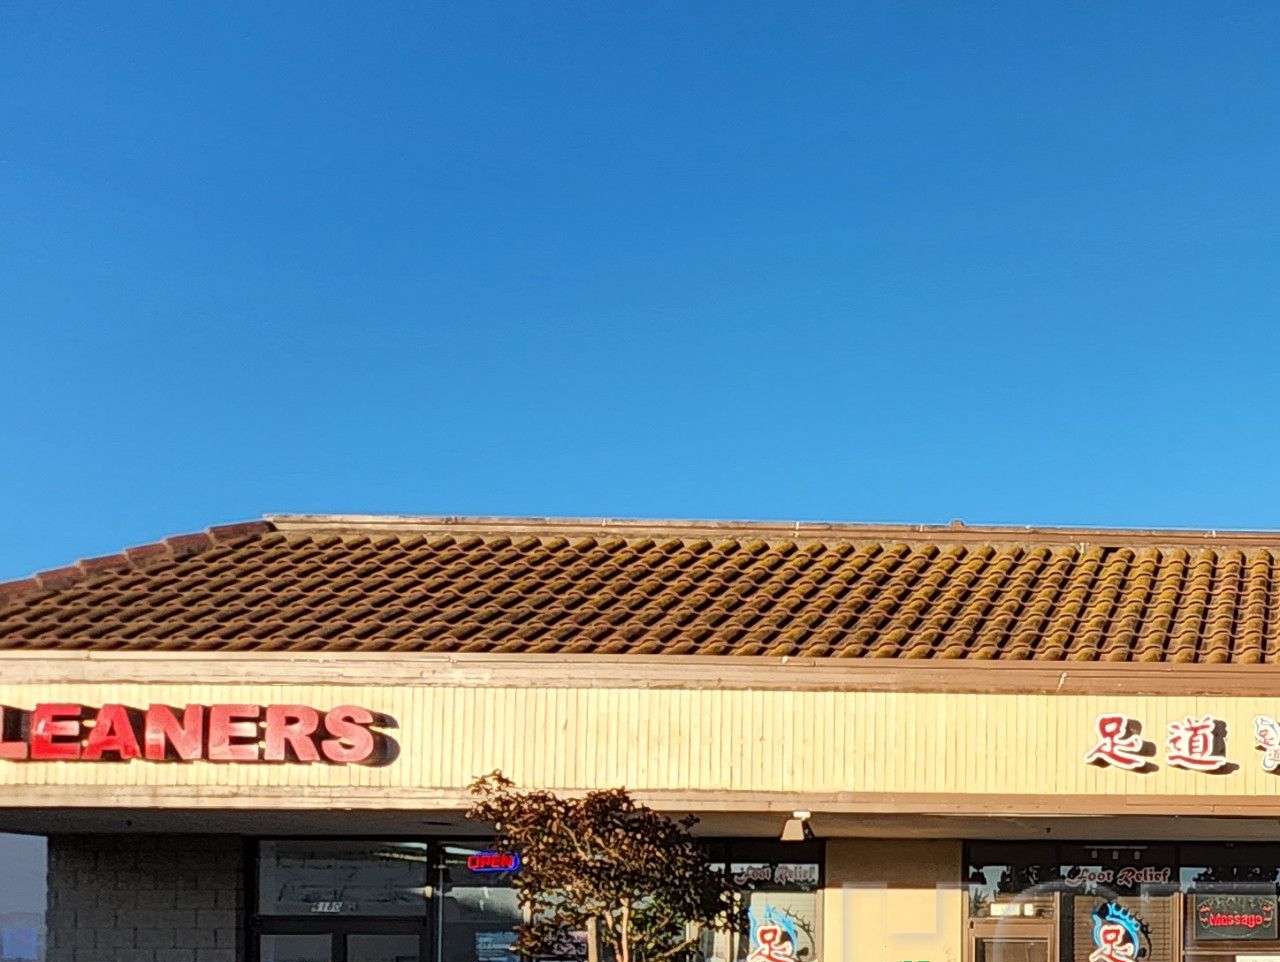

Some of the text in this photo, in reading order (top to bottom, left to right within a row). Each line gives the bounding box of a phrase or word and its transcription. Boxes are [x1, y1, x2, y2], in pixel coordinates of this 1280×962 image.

[467, 855, 515, 869] OPEN
[1065, 867, 1171, 887] Foot Relief
